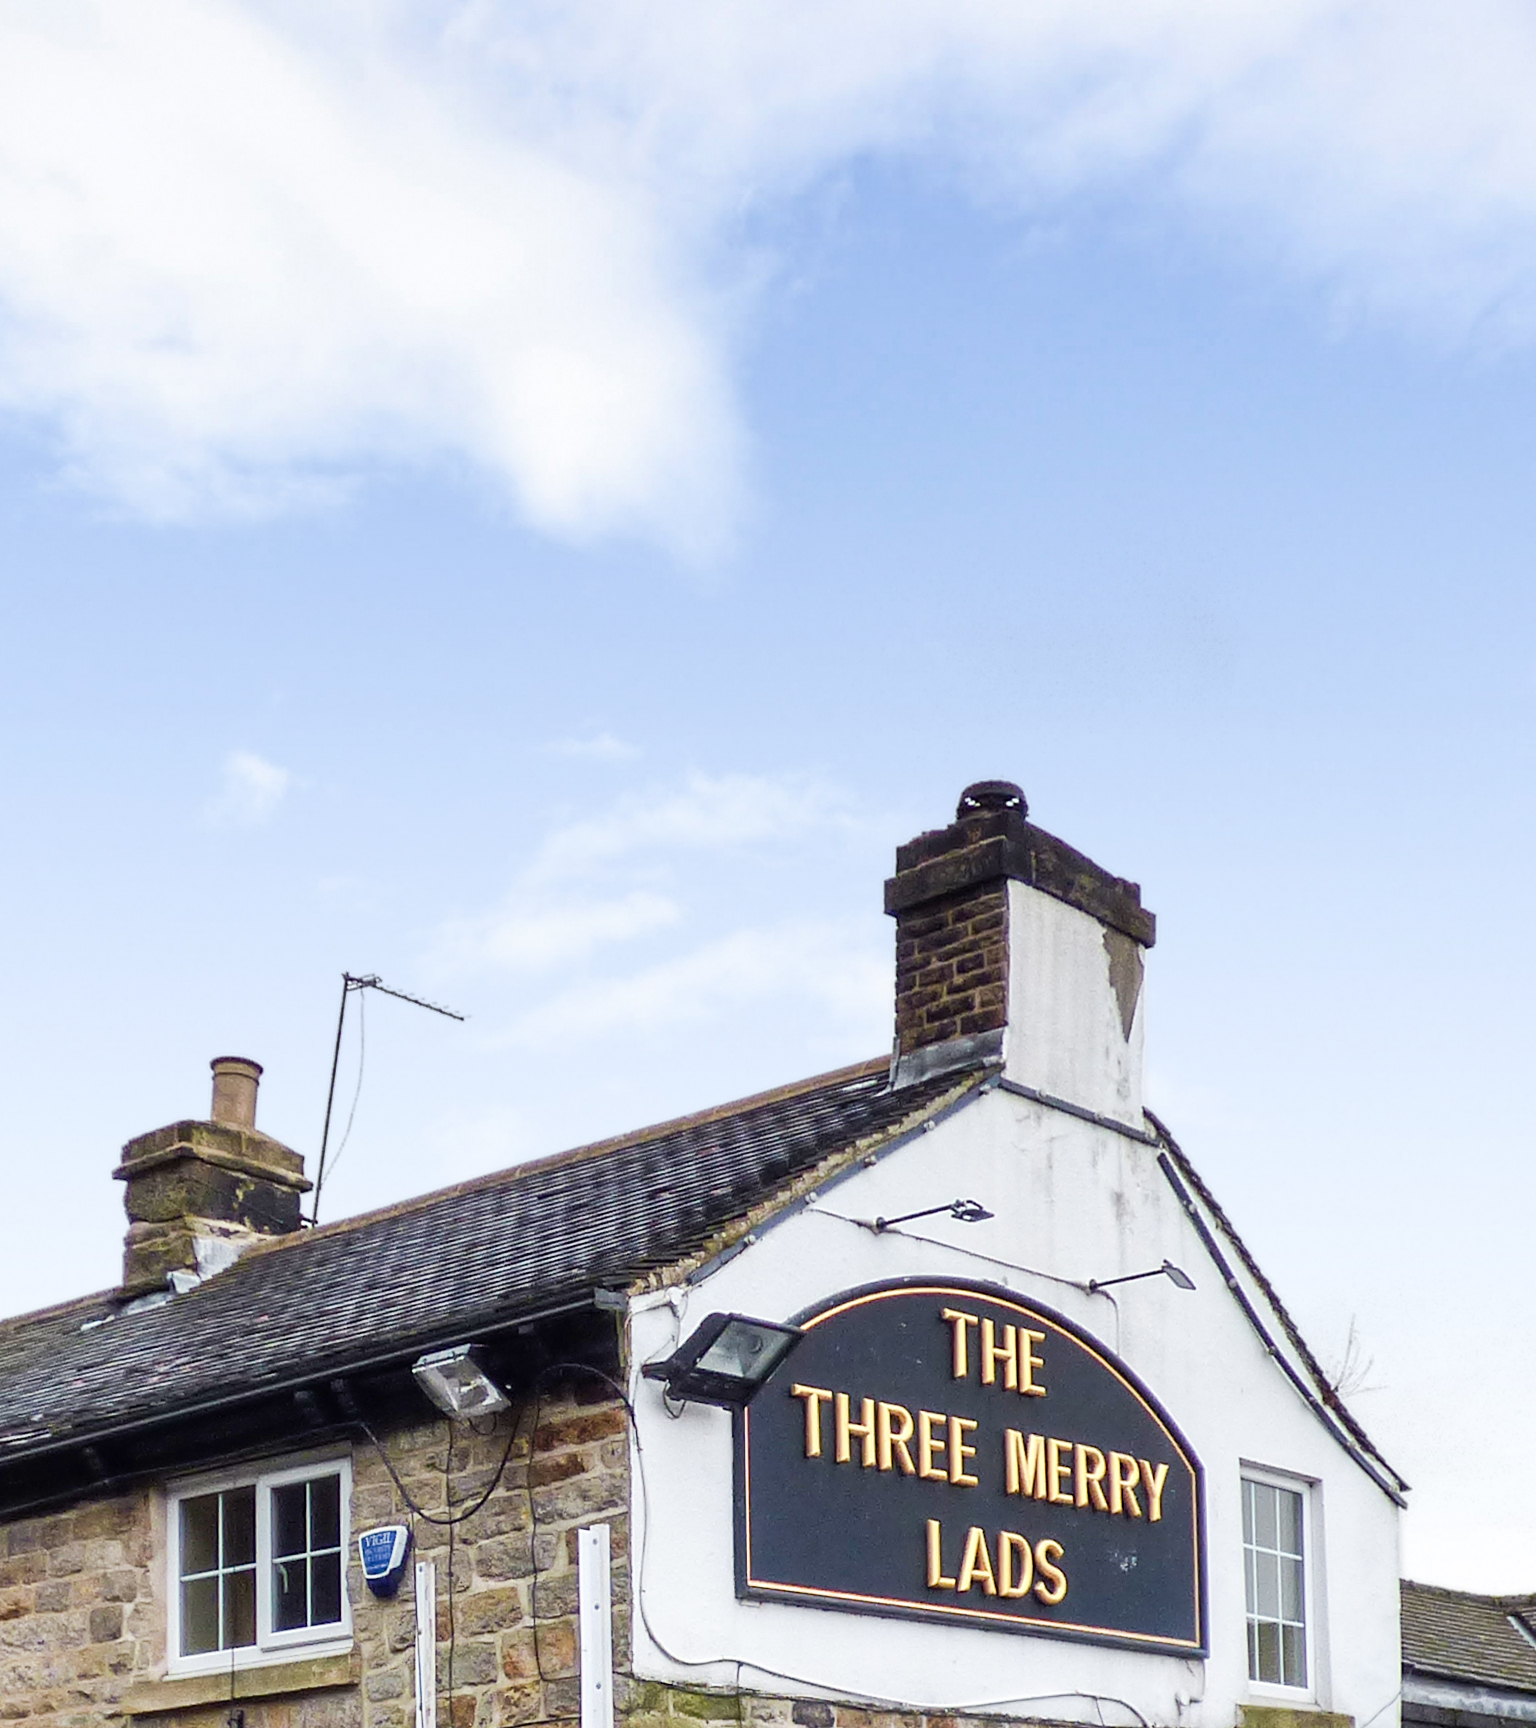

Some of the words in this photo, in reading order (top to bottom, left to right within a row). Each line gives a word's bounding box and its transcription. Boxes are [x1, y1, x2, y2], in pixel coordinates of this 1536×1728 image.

[941, 1307, 1047, 1397] THE
[790, 1383, 979, 1487] THREE
[1004, 1428, 1170, 1522] MERRY
[925, 1519, 1068, 1606] LADS
